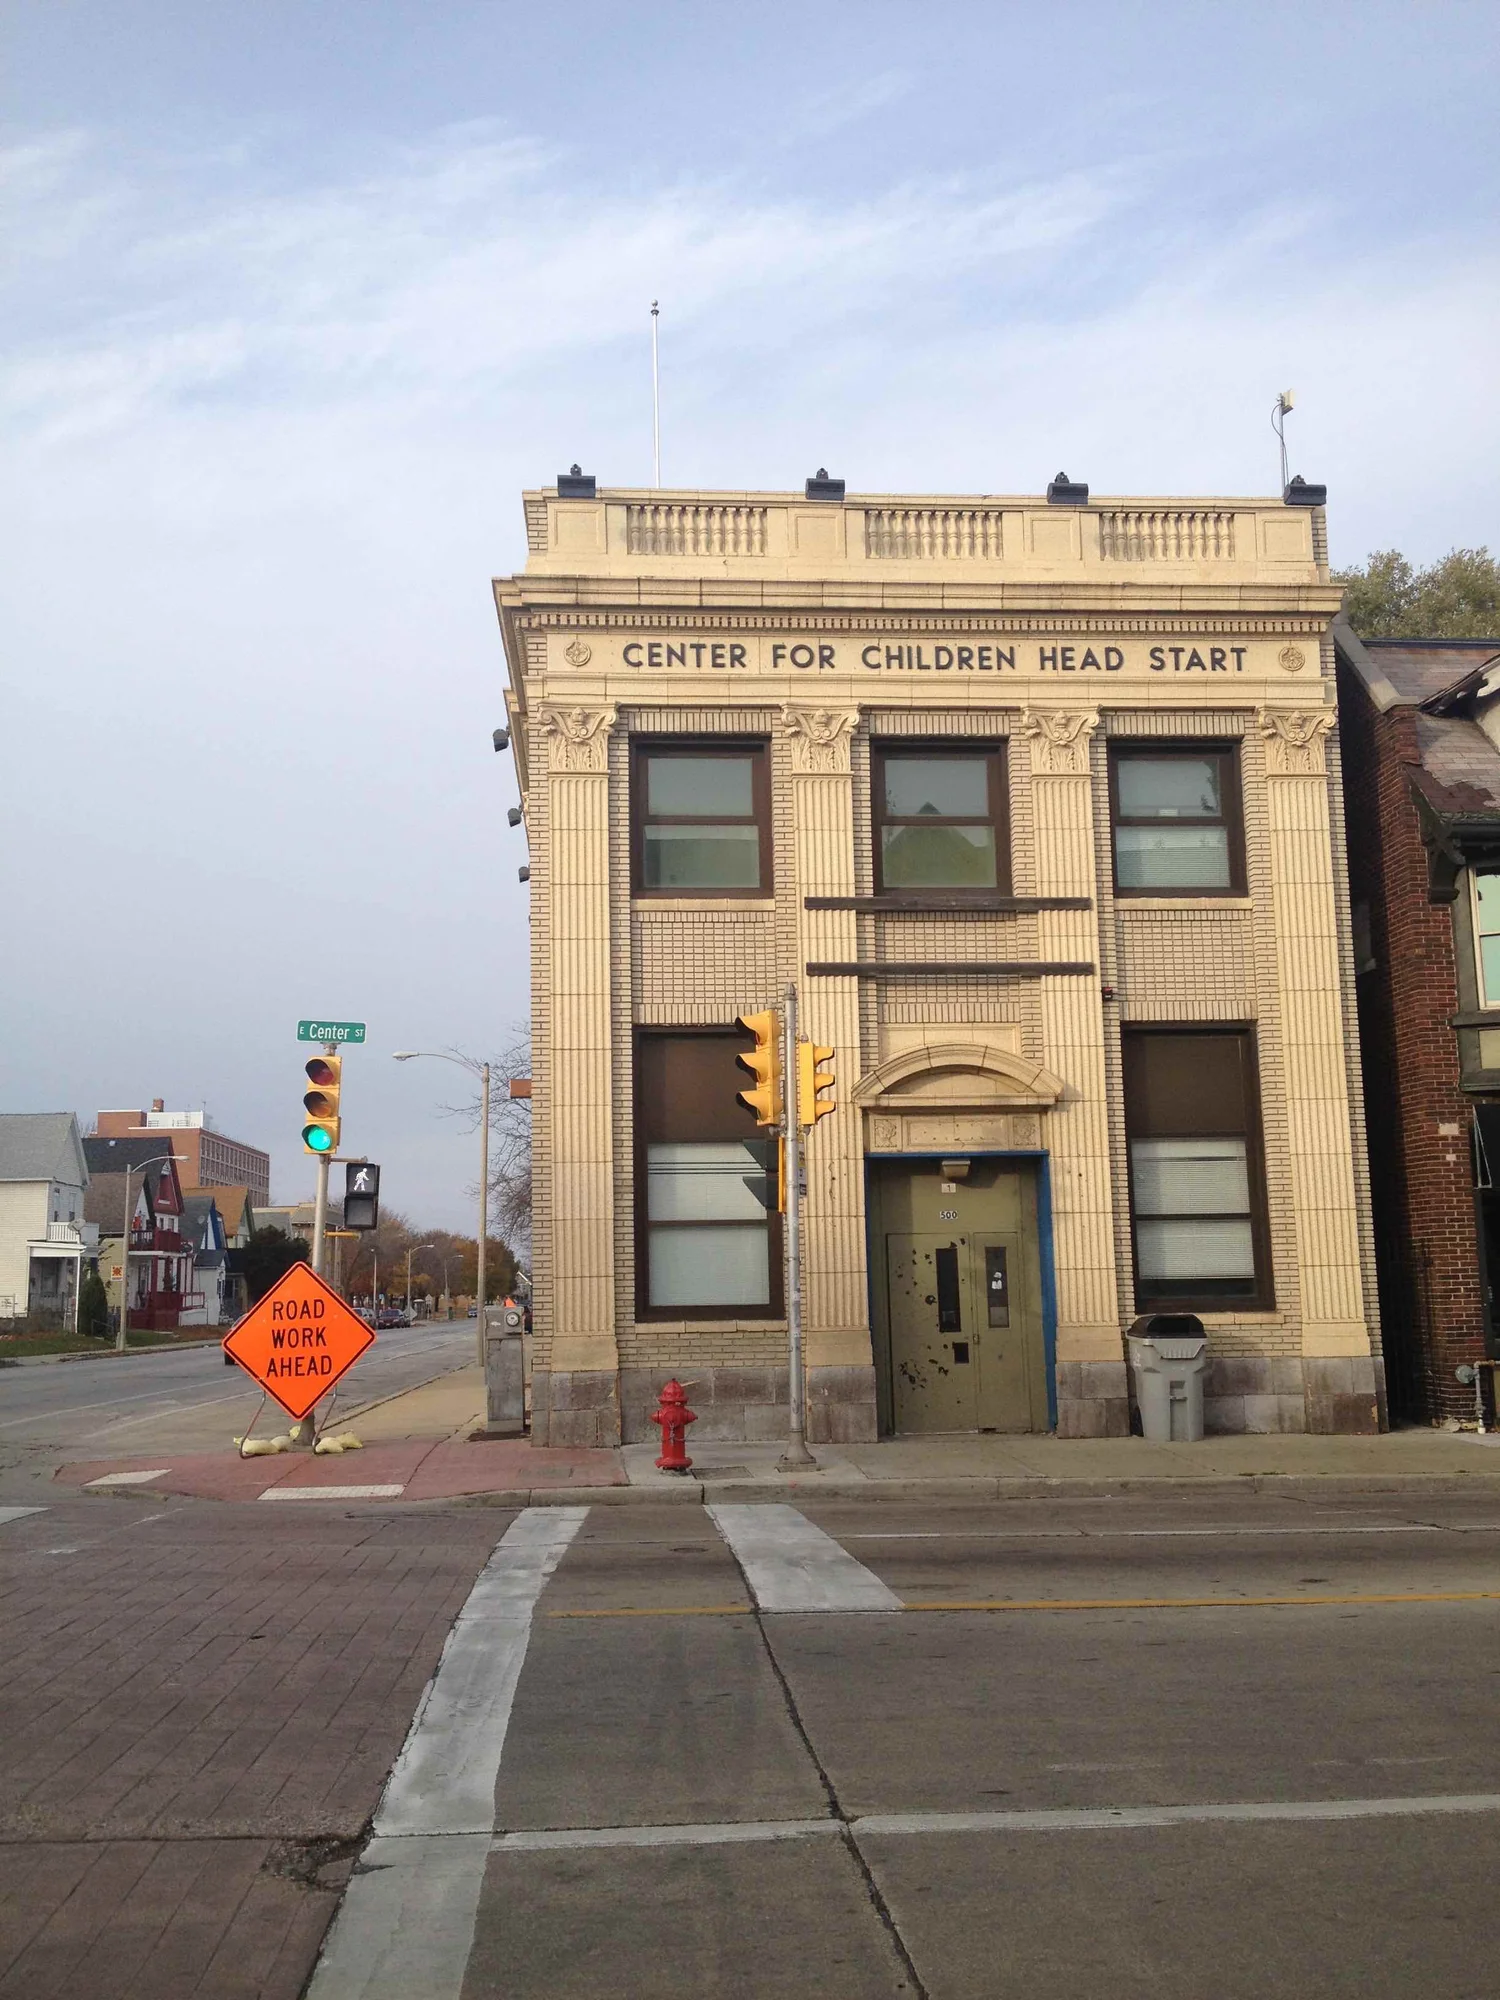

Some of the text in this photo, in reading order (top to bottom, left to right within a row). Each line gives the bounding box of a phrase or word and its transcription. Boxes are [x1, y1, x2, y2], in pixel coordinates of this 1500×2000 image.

[622, 642, 1248, 672] CENTER FOR CHILDREN HEAD START
[299, 1023, 364, 1040] E Center ST
[940, 1211, 957, 1219] 500
[272, 1299, 325, 1321] ROAD
[271, 1326, 327, 1349] WORK
[266, 1355, 332, 1378] AHEAD
